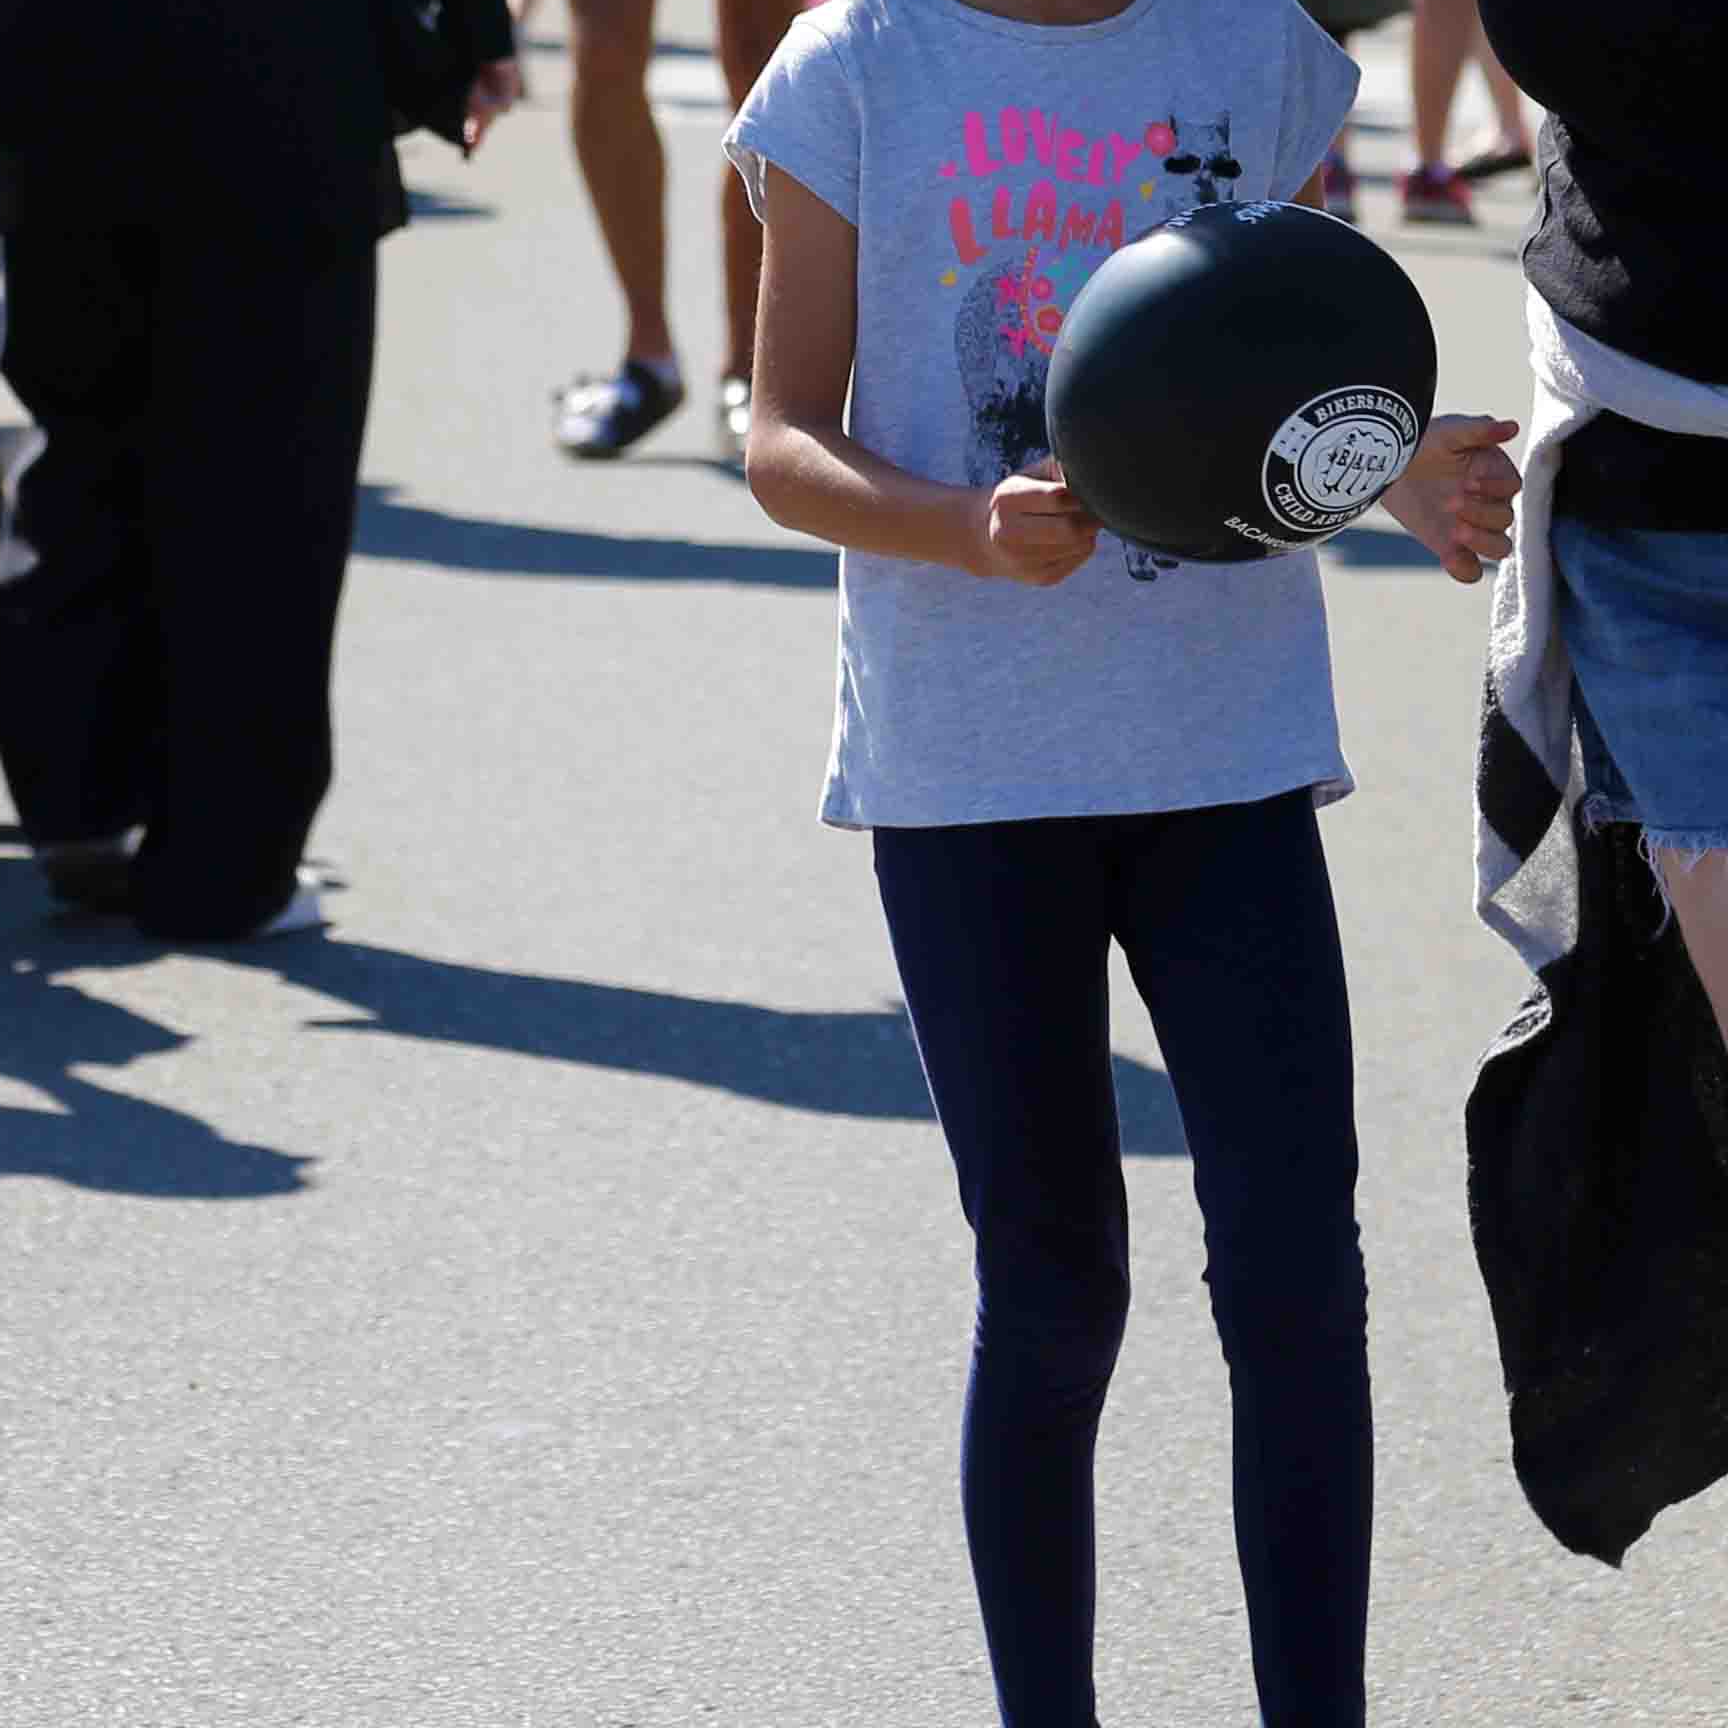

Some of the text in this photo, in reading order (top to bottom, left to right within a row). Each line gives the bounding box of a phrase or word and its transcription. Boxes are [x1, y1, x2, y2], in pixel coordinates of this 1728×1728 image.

[963, 105, 1143, 186] LOVELY
[949, 177, 1125, 266] LLAMA
[1314, 393, 1375, 423] BIKERS
[1274, 482, 1315, 523] CHILD
